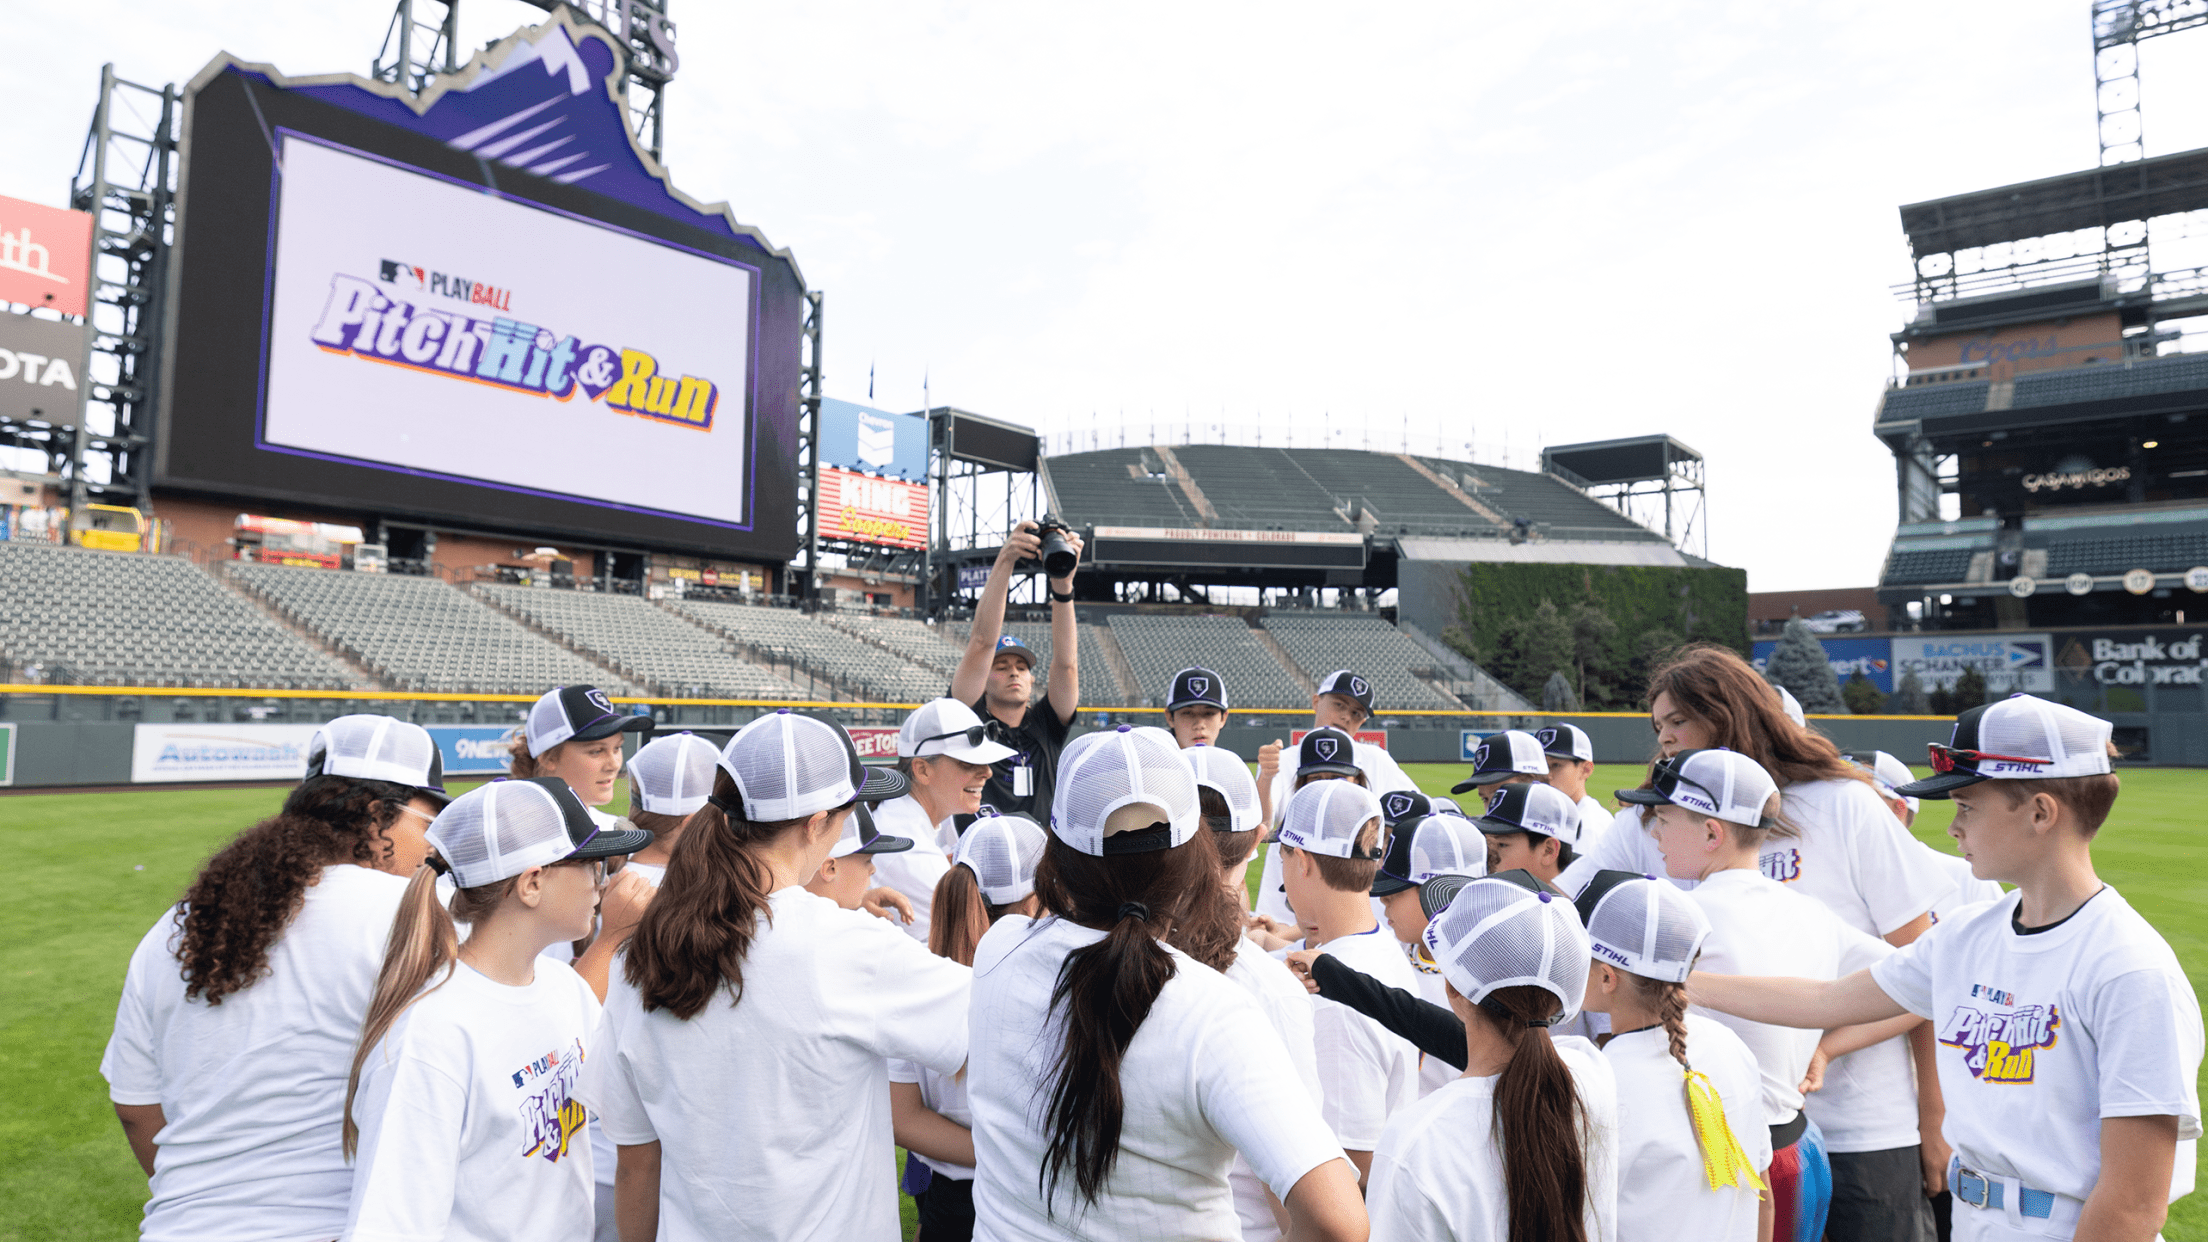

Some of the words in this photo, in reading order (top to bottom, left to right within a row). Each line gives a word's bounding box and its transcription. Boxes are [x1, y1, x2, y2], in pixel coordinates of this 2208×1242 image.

[475, 316, 578, 394] Hit
[577, 347, 616, 388] &
[605, 347, 716, 424] Run
[840, 476, 911, 516] KING
[838, 506, 911, 541] Soopers
[2092, 635, 2167, 661] Bank
[2168, 633, 2203, 660] of
[157, 743, 299, 762] Autowash
[1994, 763, 2043, 773] STIHL
[1681, 795, 1712, 811] STIHL
[1283, 830, 1305, 846] STIHL
[1532, 822, 1556, 835] STIHL
[1592, 943, 1630, 967] STIHL
[1983, 1040, 2033, 1080] Run
